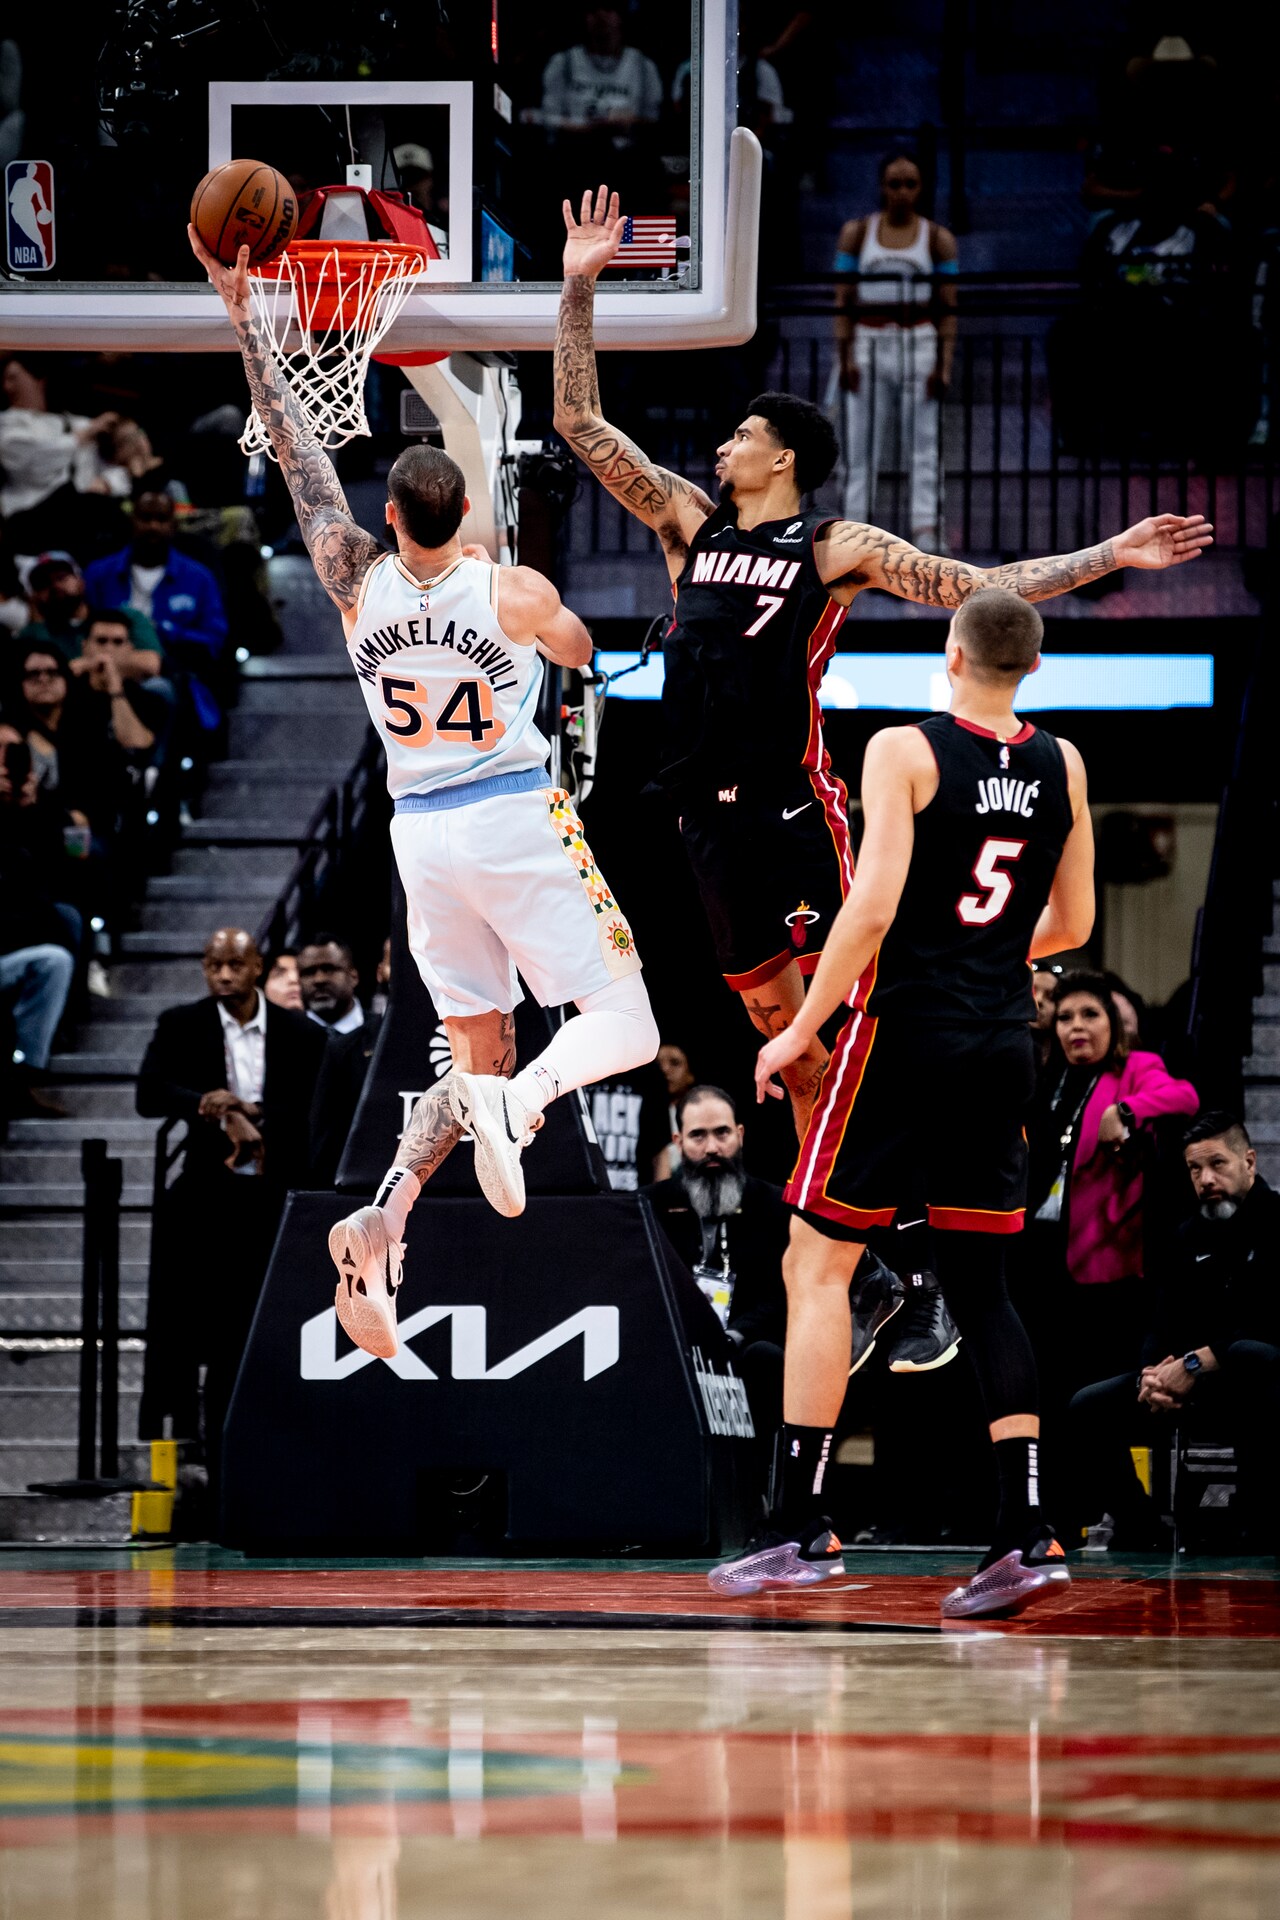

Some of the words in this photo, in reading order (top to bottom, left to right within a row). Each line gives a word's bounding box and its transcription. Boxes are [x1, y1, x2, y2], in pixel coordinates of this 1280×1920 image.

[14, 246, 37, 264] NBA
[691, 551, 802, 589] MIAMI
[742, 594, 786, 637] 7
[355, 617, 518, 693] MAMUKELASHVILI
[380, 676, 501, 747] 54
[975, 777, 1041, 818] JOVIĆ
[955, 836, 1029, 927] 5
[300, 1305, 620, 1381] KIA
